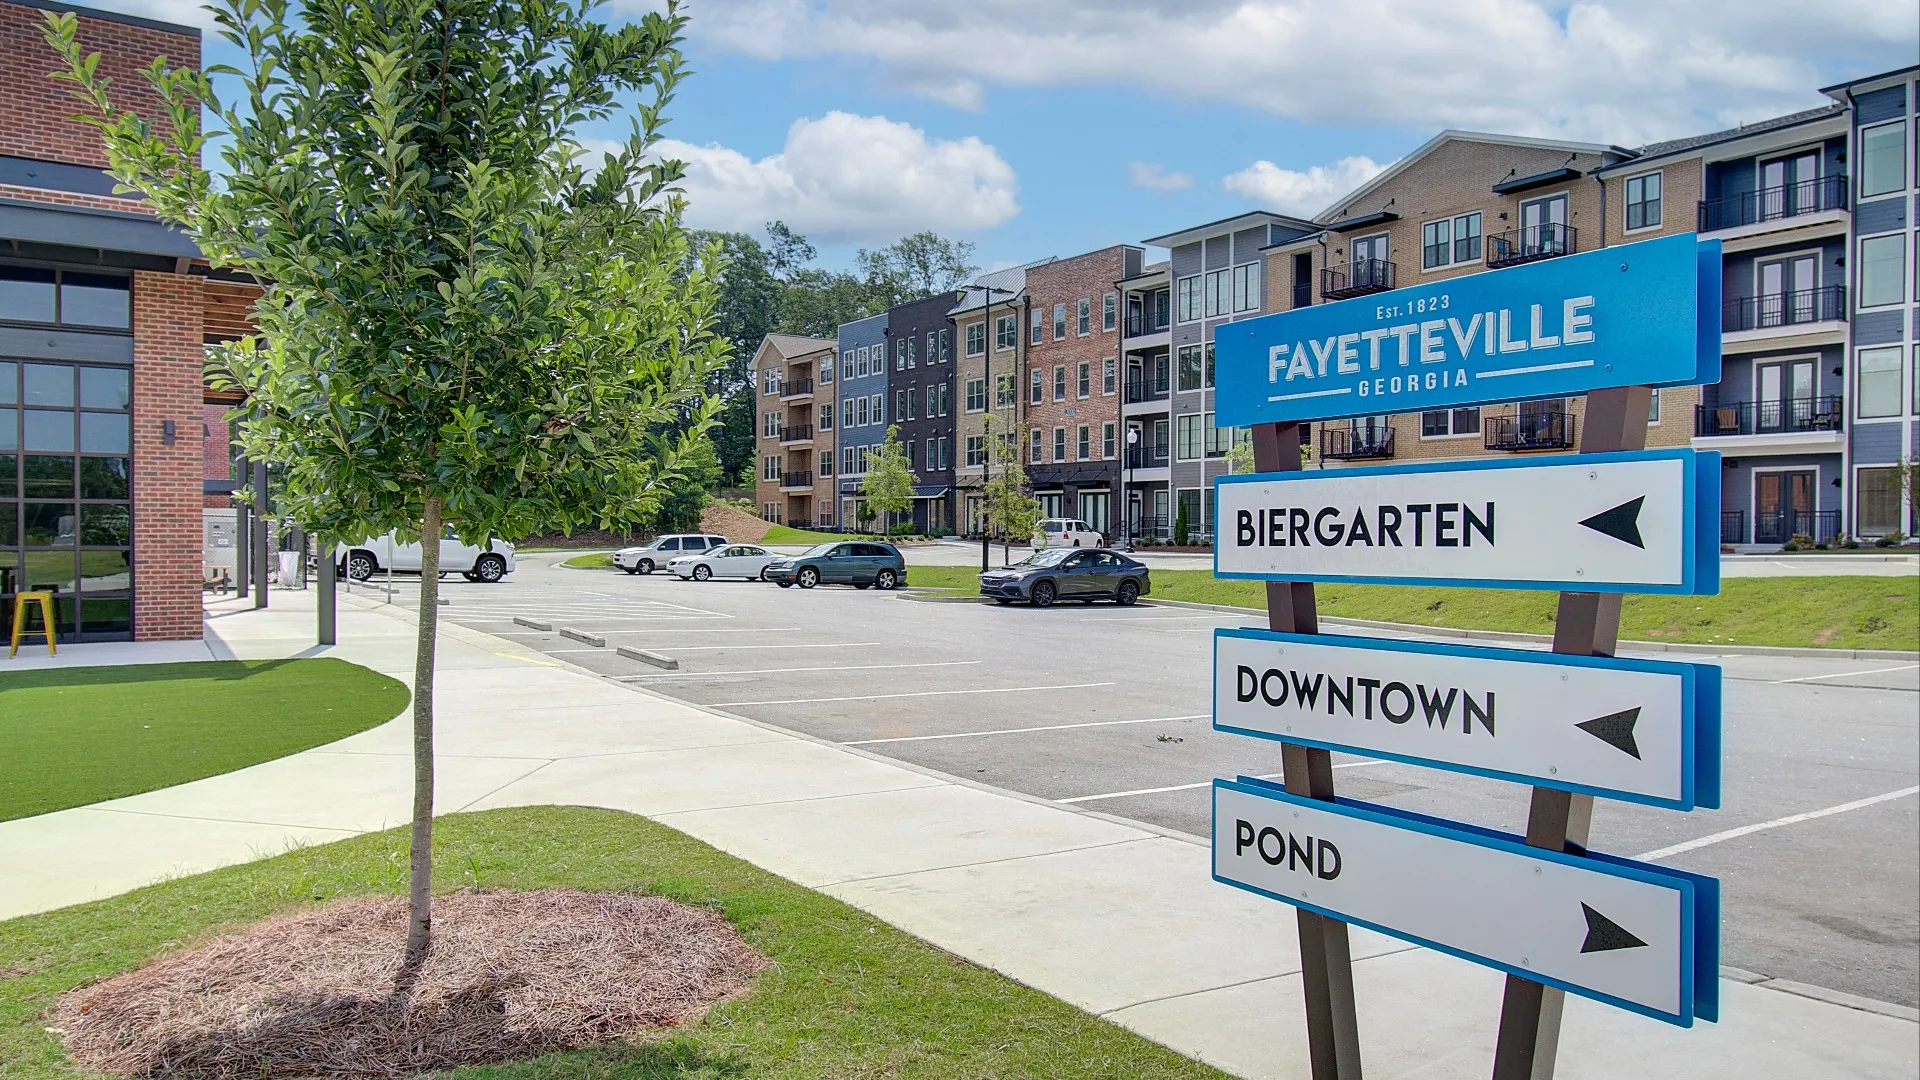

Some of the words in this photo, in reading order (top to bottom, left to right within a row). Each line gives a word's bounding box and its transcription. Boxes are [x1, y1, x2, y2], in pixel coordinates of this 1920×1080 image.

[1407, 294, 1449, 315] 1823
[1268, 295, 1596, 384] FAYETTEVILLE
[1358, 368, 1468, 397] GEORGIA
[1236, 501, 1495, 548] BIERGARTEN
[1236, 664, 1495, 738] DOWNTOWN
[1235, 819, 1342, 880] POND
